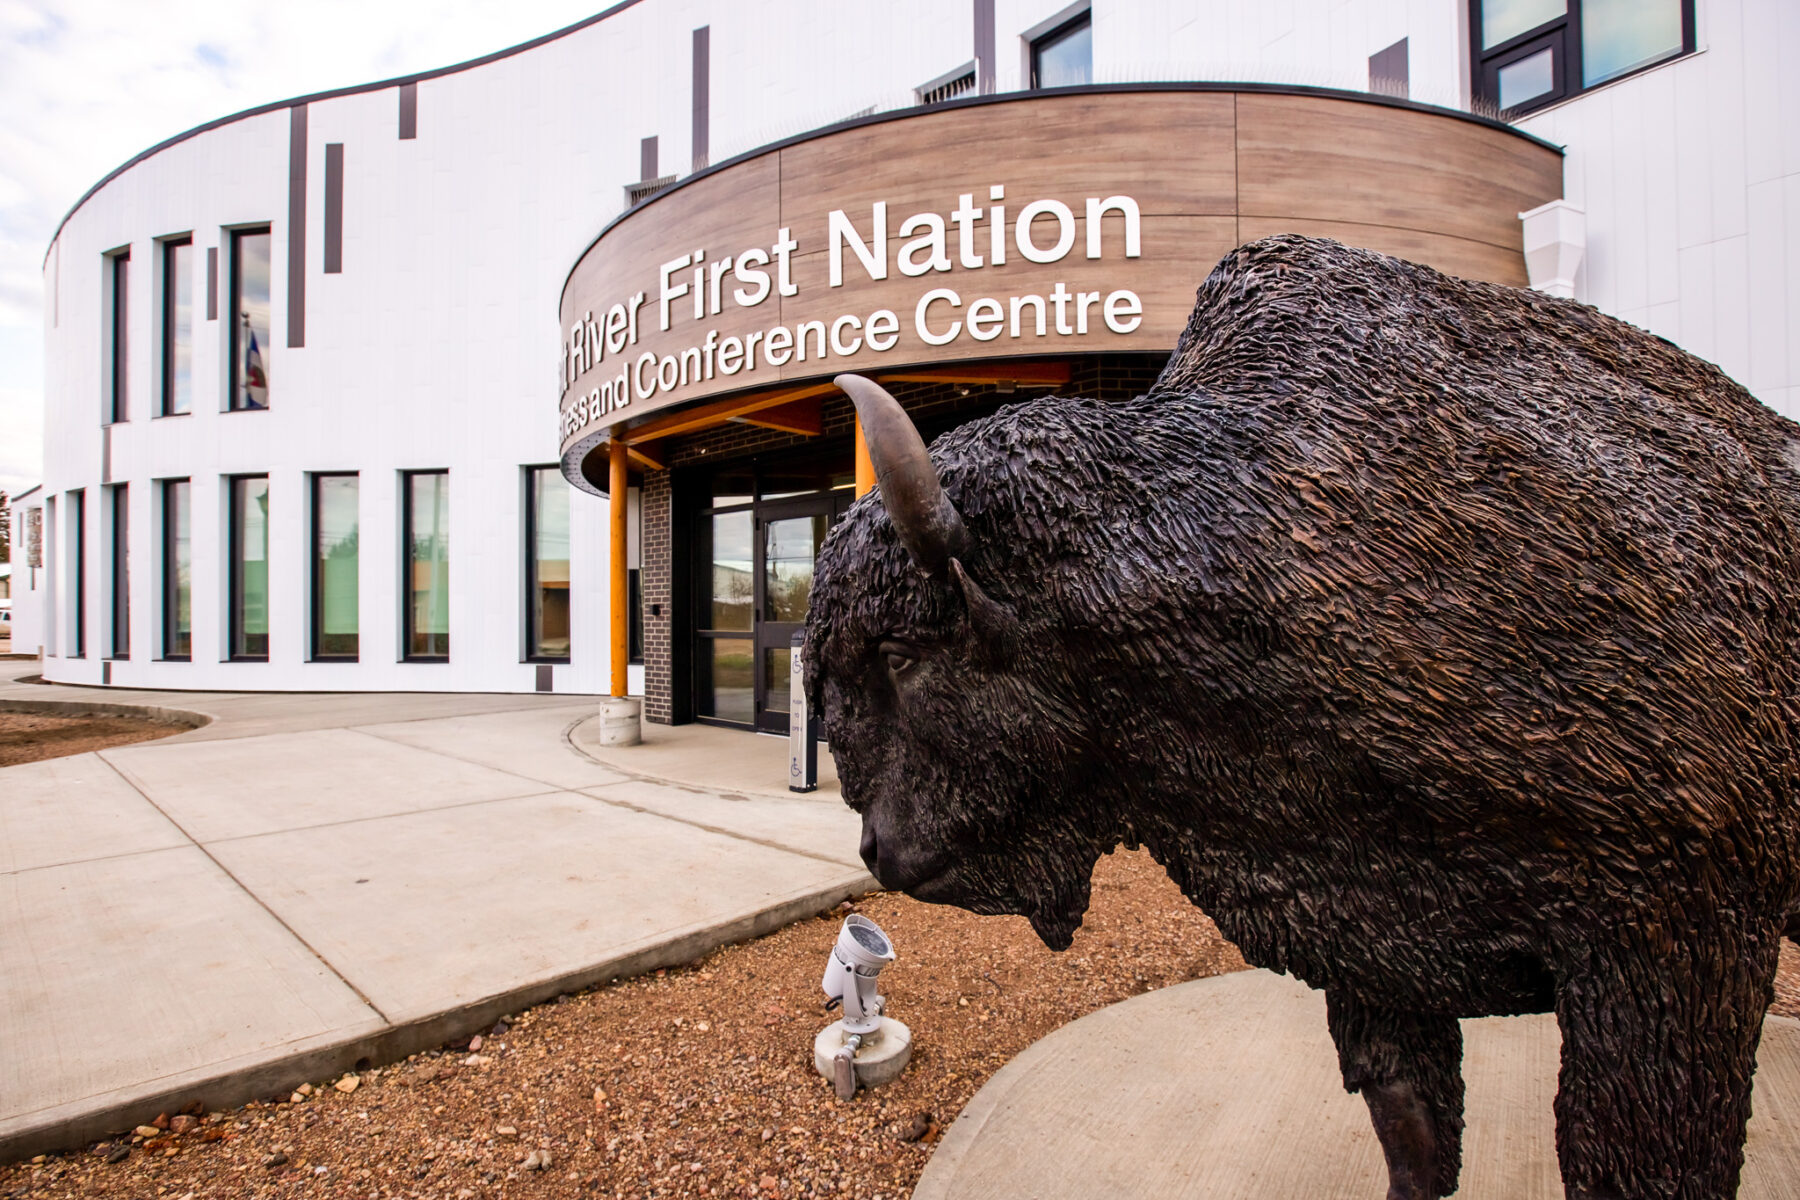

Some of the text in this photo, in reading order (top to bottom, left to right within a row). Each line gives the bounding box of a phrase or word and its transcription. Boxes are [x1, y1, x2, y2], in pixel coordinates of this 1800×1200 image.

[571, 291, 645, 382] River
[660, 227, 798, 332] First
[828, 184, 1142, 288] Nation
[590, 362, 631, 421] and
[635, 309, 900, 400] Conference
[914, 282, 1143, 347] Centre
